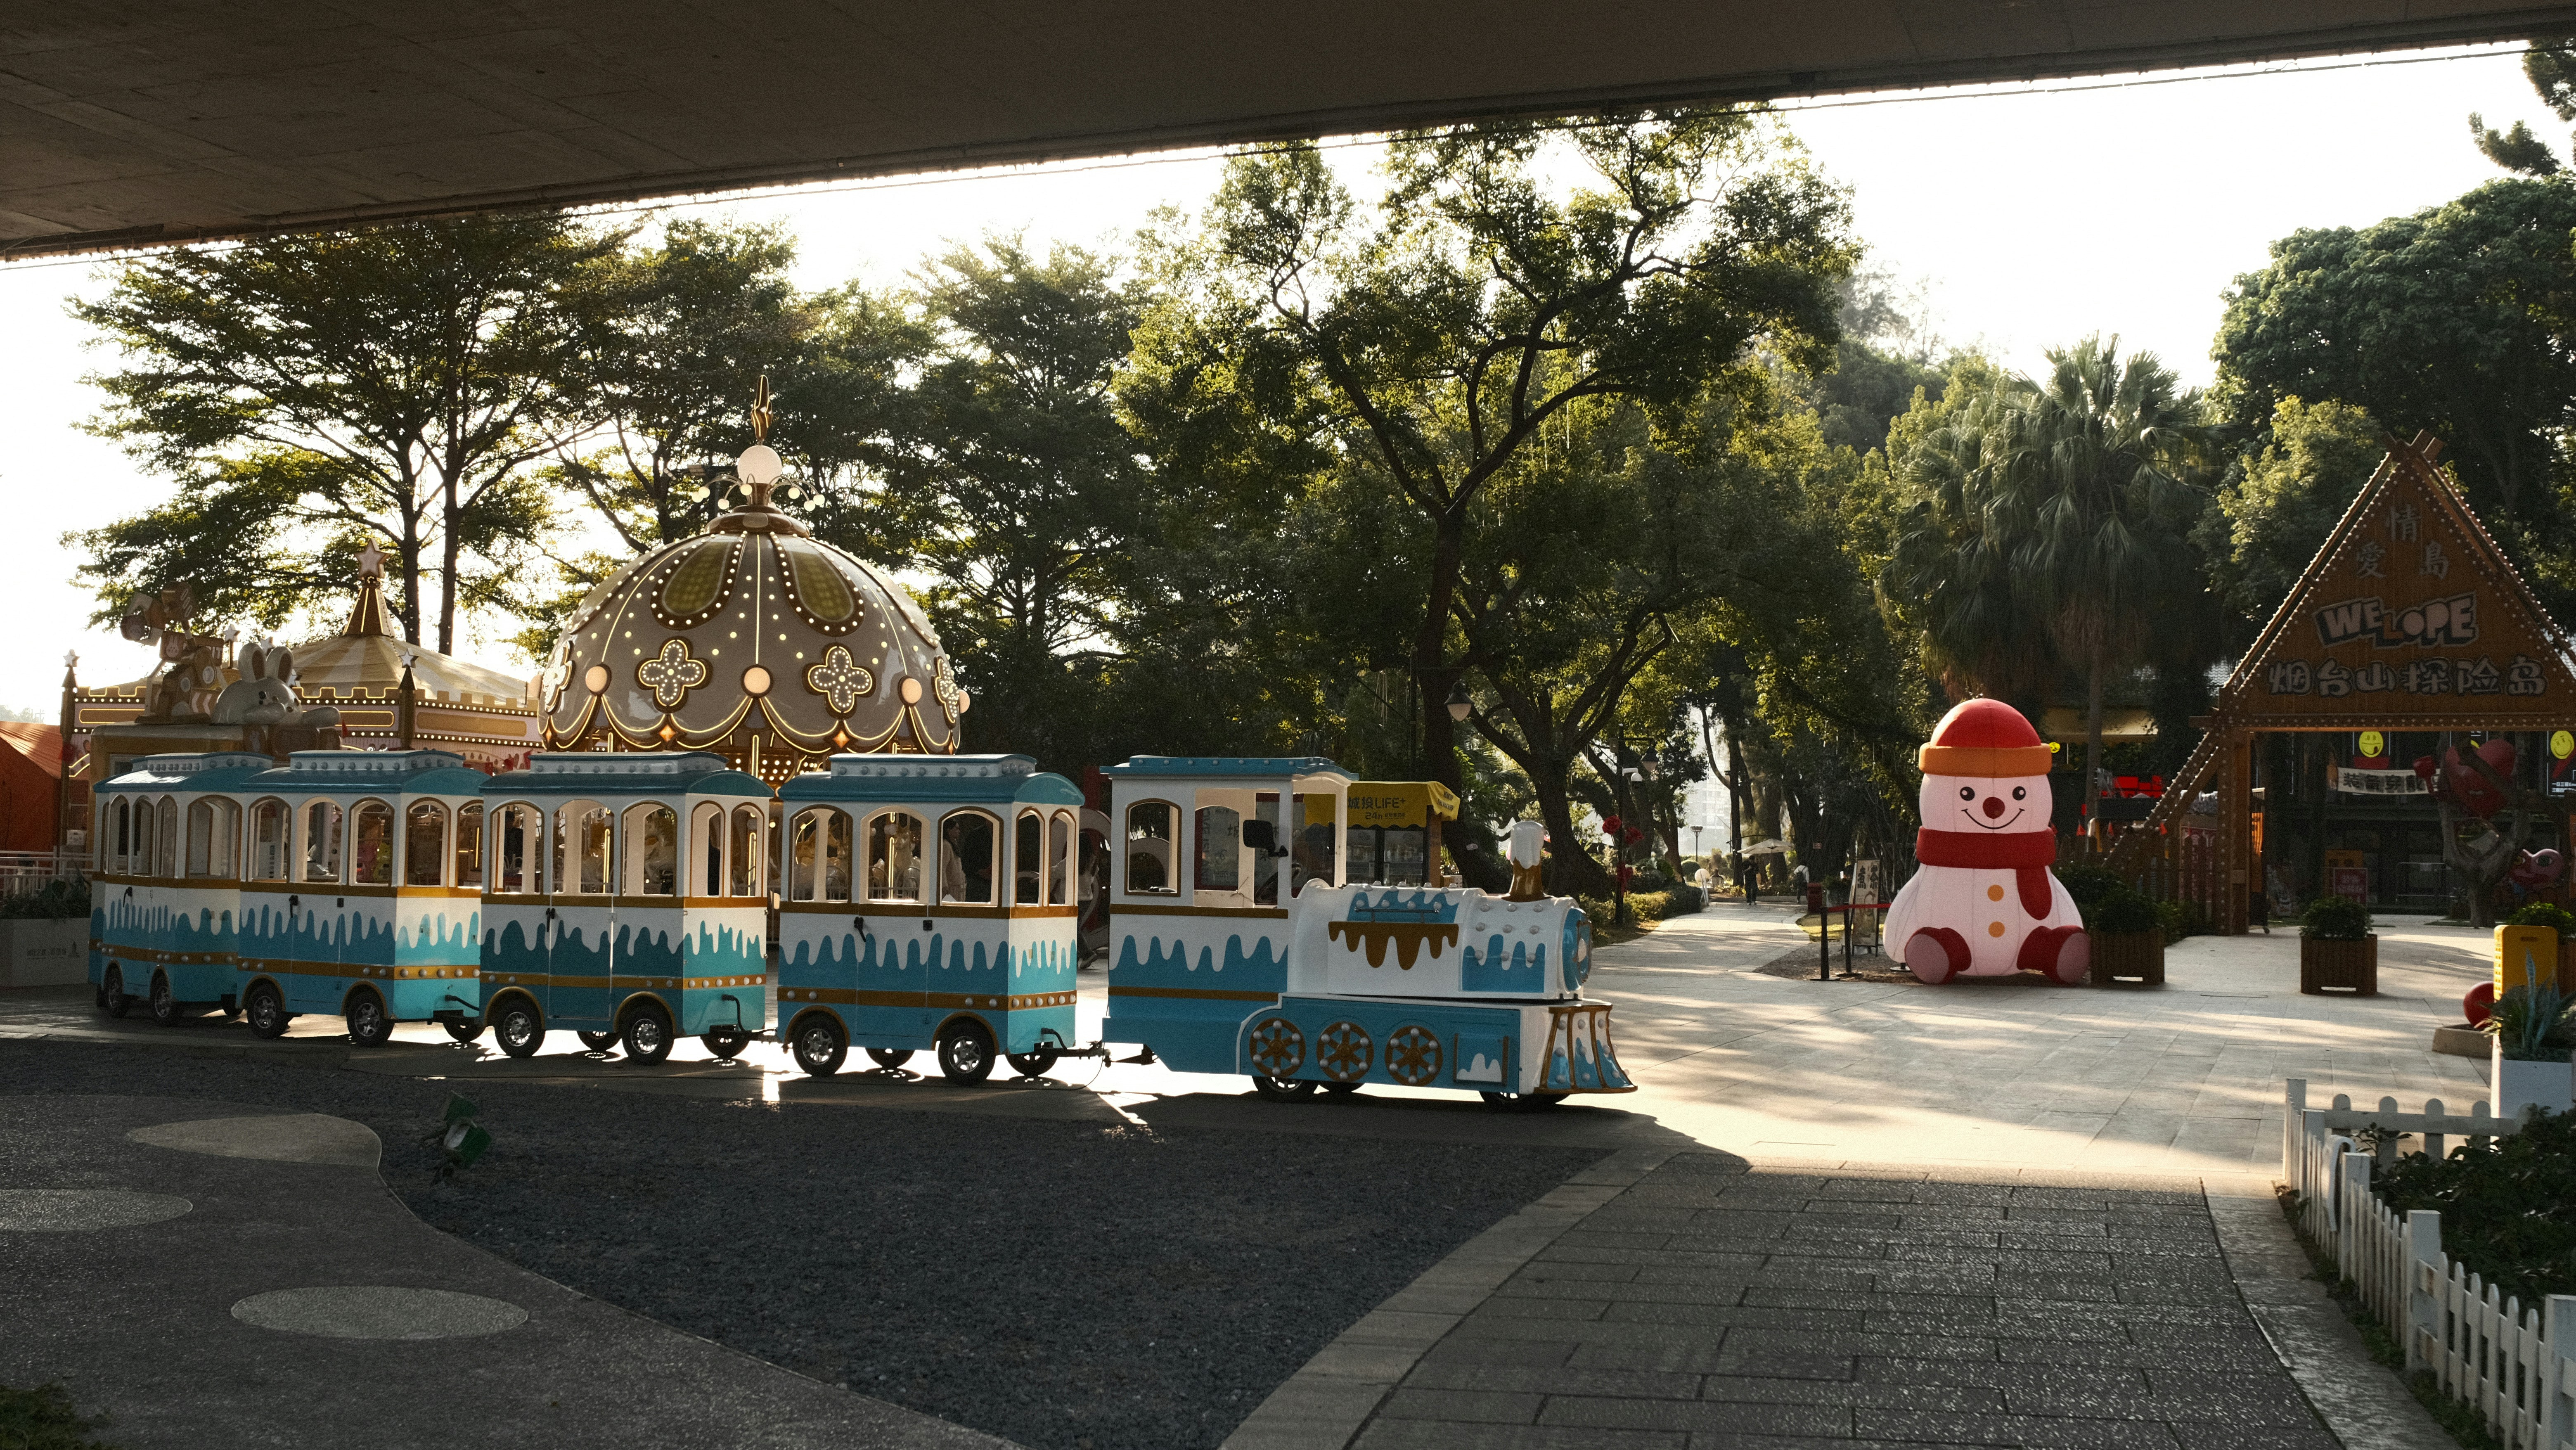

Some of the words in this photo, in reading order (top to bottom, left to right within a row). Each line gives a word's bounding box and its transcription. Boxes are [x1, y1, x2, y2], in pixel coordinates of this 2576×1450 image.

[2268, 654, 2547, 697] 烟台山探险岛
[2343, 772, 2439, 792] 装备穿戴
